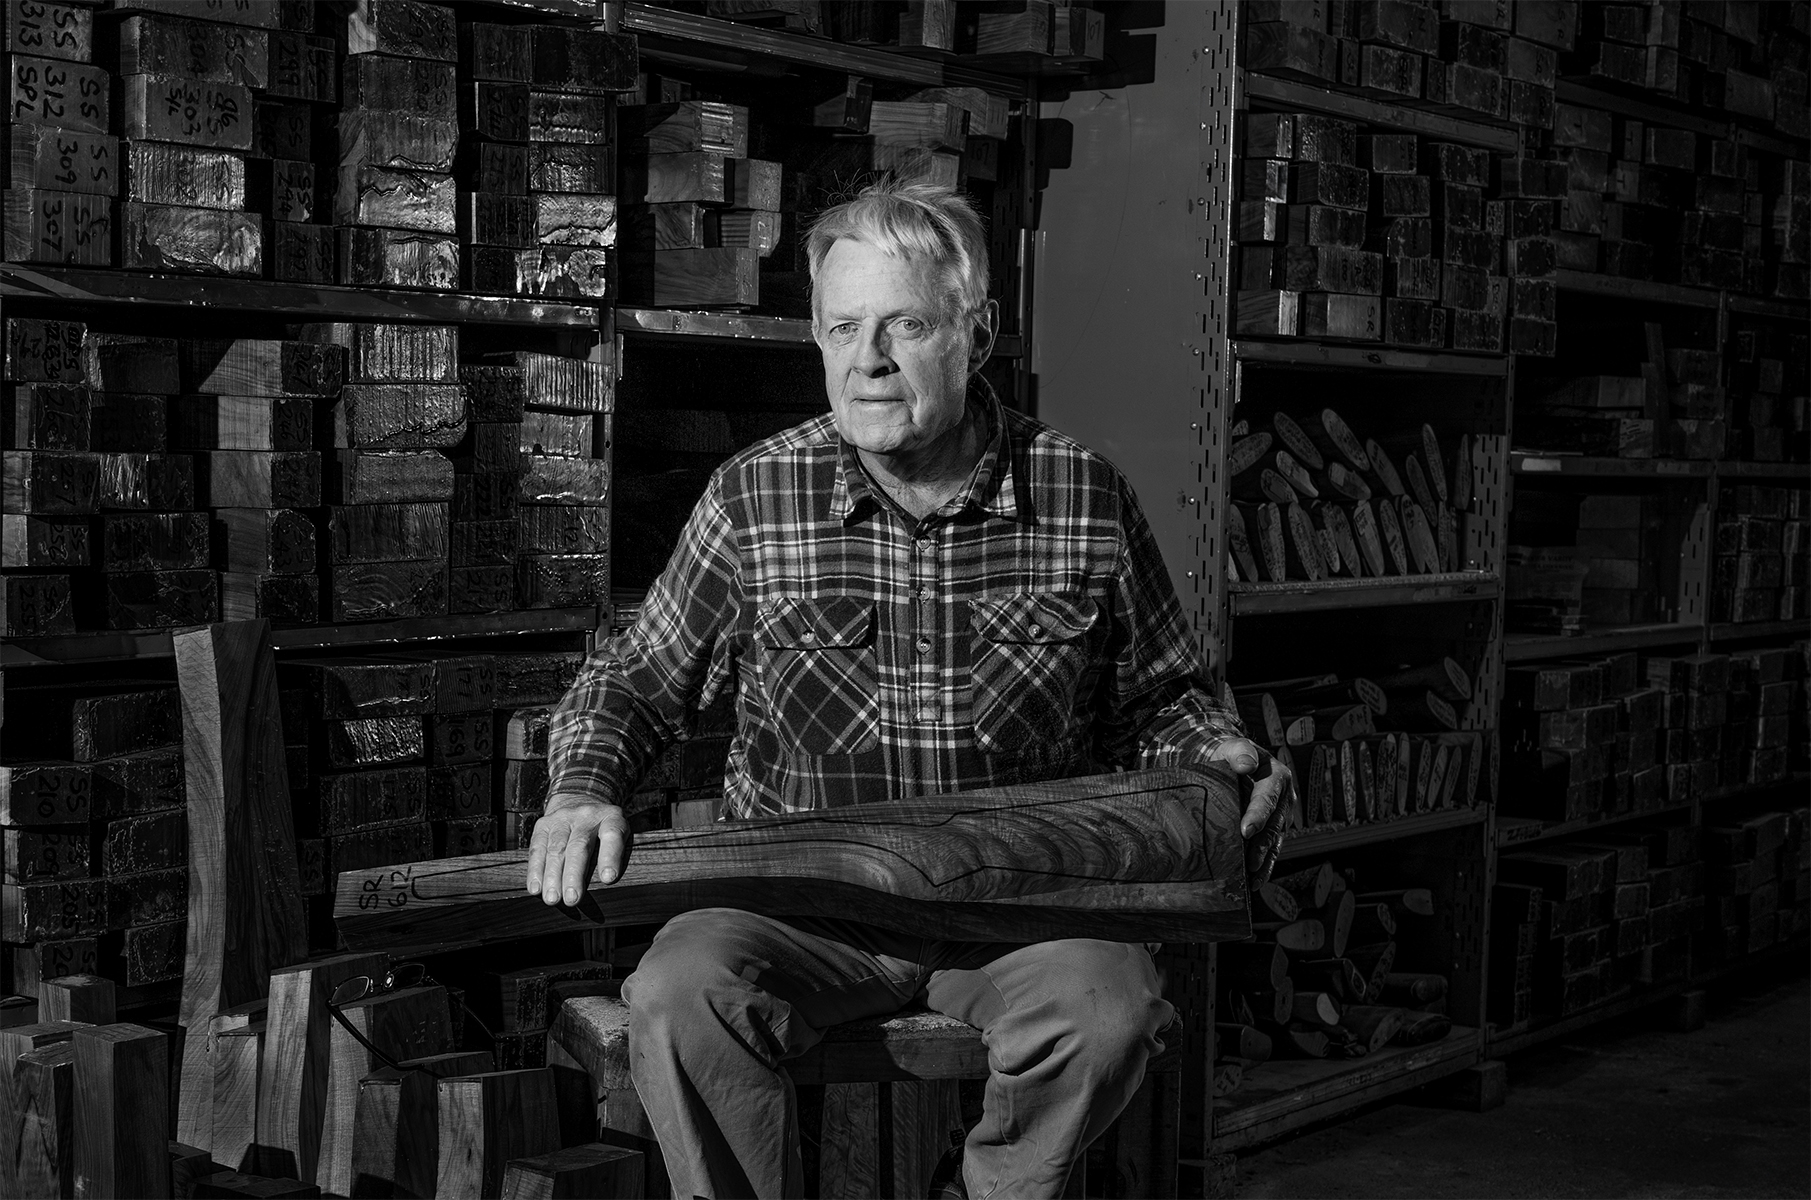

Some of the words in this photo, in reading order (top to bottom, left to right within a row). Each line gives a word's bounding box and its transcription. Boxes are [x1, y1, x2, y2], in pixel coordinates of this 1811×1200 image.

[19, 1, 45, 47] 313
[52, 9, 77, 49] SS
[278, 42, 300, 85] 299
[16, 66, 37, 118] SPL
[43, 66, 66, 119] 312
[79, 77, 101, 119] SS
[181, 84, 201, 136] 303
[289, 117, 303, 147] SS
[55, 138, 77, 185] 309
[90, 145, 108, 182] SS
[511, 155, 522, 180] SS
[42, 200, 62, 253] 307
[74, 207, 91, 246] SS
[315, 241, 330, 272] SS
[1366, 306, 1375, 332] SR
[278, 407, 293, 440] 246
[296, 413, 307, 443] SS
[56, 463, 76, 506] 257
[83, 472, 94, 498] SS
[500, 481, 516, 510] SS
[72, 527, 85, 551] SS
[20, 585, 35, 628] 255
[44, 586, 58, 615] SS
[494, 574, 508, 603] SS
[480, 669, 493, 695] SS
[446, 720, 464, 758] 169
[475, 720, 489, 752] SS
[37, 774, 60, 818] 210
[66, 777, 88, 813] SS
[408, 780, 421, 813] SS
[460, 773, 481, 809] SS
[358, 874, 383, 910] SR
[388, 866, 412, 907] 612
[61, 886, 79, 934] 205
[87, 892, 104, 927] SS
